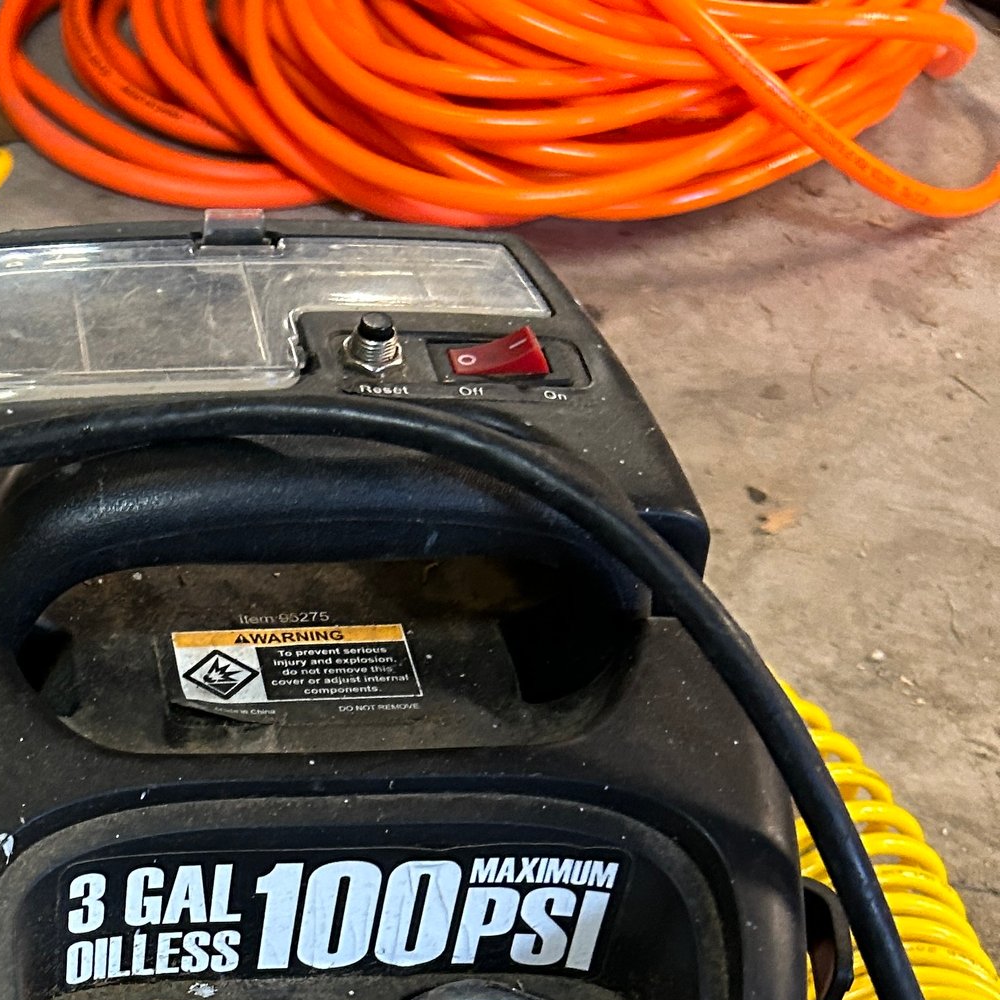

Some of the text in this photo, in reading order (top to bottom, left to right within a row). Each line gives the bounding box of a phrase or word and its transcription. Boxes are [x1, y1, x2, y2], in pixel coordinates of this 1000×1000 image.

[359, 384, 568, 401] Reset Off On
[240, 611, 330, 625] Item 95275
[249, 630, 344, 644] WARNING
[296, 647, 340, 657] prevent
[343, 646, 388, 655] serious
[273, 659, 307, 667] injury
[311, 657, 332, 665] and
[282, 665, 393, 676] do not remove this
[324, 676, 361, 685] adjust
[364, 674, 409, 683] internal
[304, 685, 382, 694] components.
[377, 702, 420, 711] REMOVE
[469, 857, 618, 889] MAXIMUM
[67, 863, 242, 935] 3 GAL
[254, 860, 462, 971] 100
[451, 886, 611, 971] PSI
[65, 930, 241, 984] OILLESS
